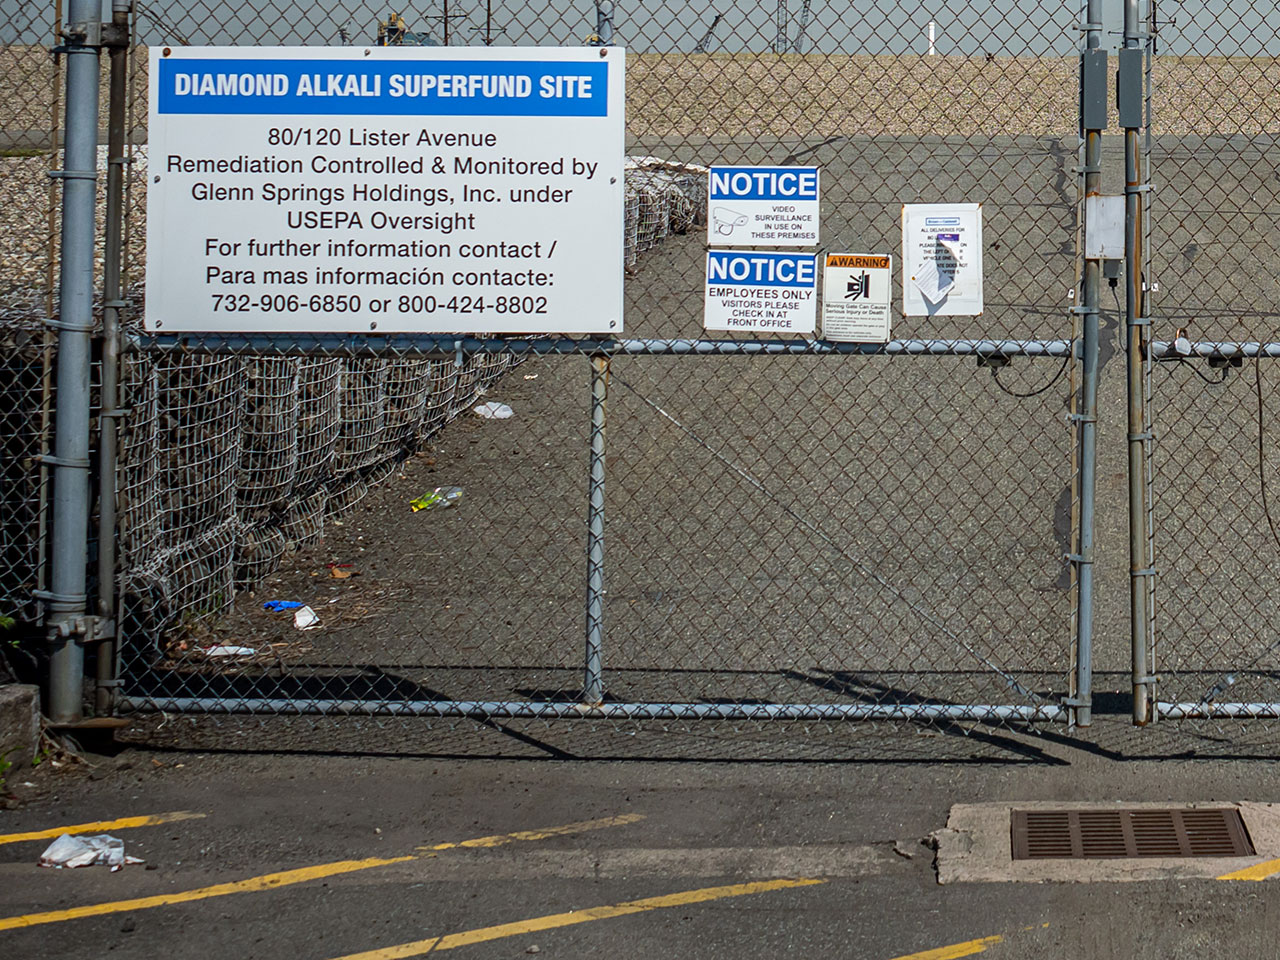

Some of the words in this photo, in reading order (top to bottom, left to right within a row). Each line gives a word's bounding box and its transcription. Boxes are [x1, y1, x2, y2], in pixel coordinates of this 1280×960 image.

[176, 74, 288, 96] DIAMOND
[296, 74, 380, 96] ALKALI
[389, 75, 531, 97] SUPERFUND
[540, 76, 592, 98] SITE
[269, 128, 340, 145] 80/120
[350, 129, 410, 146] Lister
[417, 129, 496, 146] Avenue
[168, 155, 302, 173] Remediation
[312, 156, 423, 174] Controlled
[432, 157, 445, 174] &
[455, 157, 563, 175] Monitored
[573, 158, 597, 179] by
[712, 172, 815, 196] NOTICE
[192, 183, 253, 200] Glenn
[262, 183, 344, 205] Springs
[354, 184, 453, 206] Holdings,
[464, 185, 500, 202] Inc.
[511, 186, 572, 202] under
[288, 211, 363, 228] USEPA
[371, 212, 475, 234] Oversight
[755, 214, 812, 222] SURVEILLANCE
[206, 239, 241, 256] For
[248, 239, 320, 256] further
[329, 239, 450, 257] information
[459, 242, 541, 258] contact
[548, 241, 557, 258] /
[708, 257, 814, 283] NOTICE
[839, 258, 887, 267] WARNING
[207, 267, 255, 284] Para
[264, 271, 307, 284] mas
[317, 267, 443, 285] información
[453, 270, 553, 286] contacte:
[709, 288, 779, 298] EMPLOYEES
[782, 289, 812, 300] ONLY
[212, 295, 360, 312] 732-906-6850
[369, 300, 391, 312] or
[399, 296, 547, 313] 800-424-8802
[722, 300, 762, 308] VISITORS
[765, 301, 799, 310] PLEASE
[728, 318, 757, 327] FRONT
[760, 319, 791, 328] OFFICE
[732, 309, 762, 318] CHECK
[766, 310, 774, 318] IN
[776, 310, 788, 319] AT
